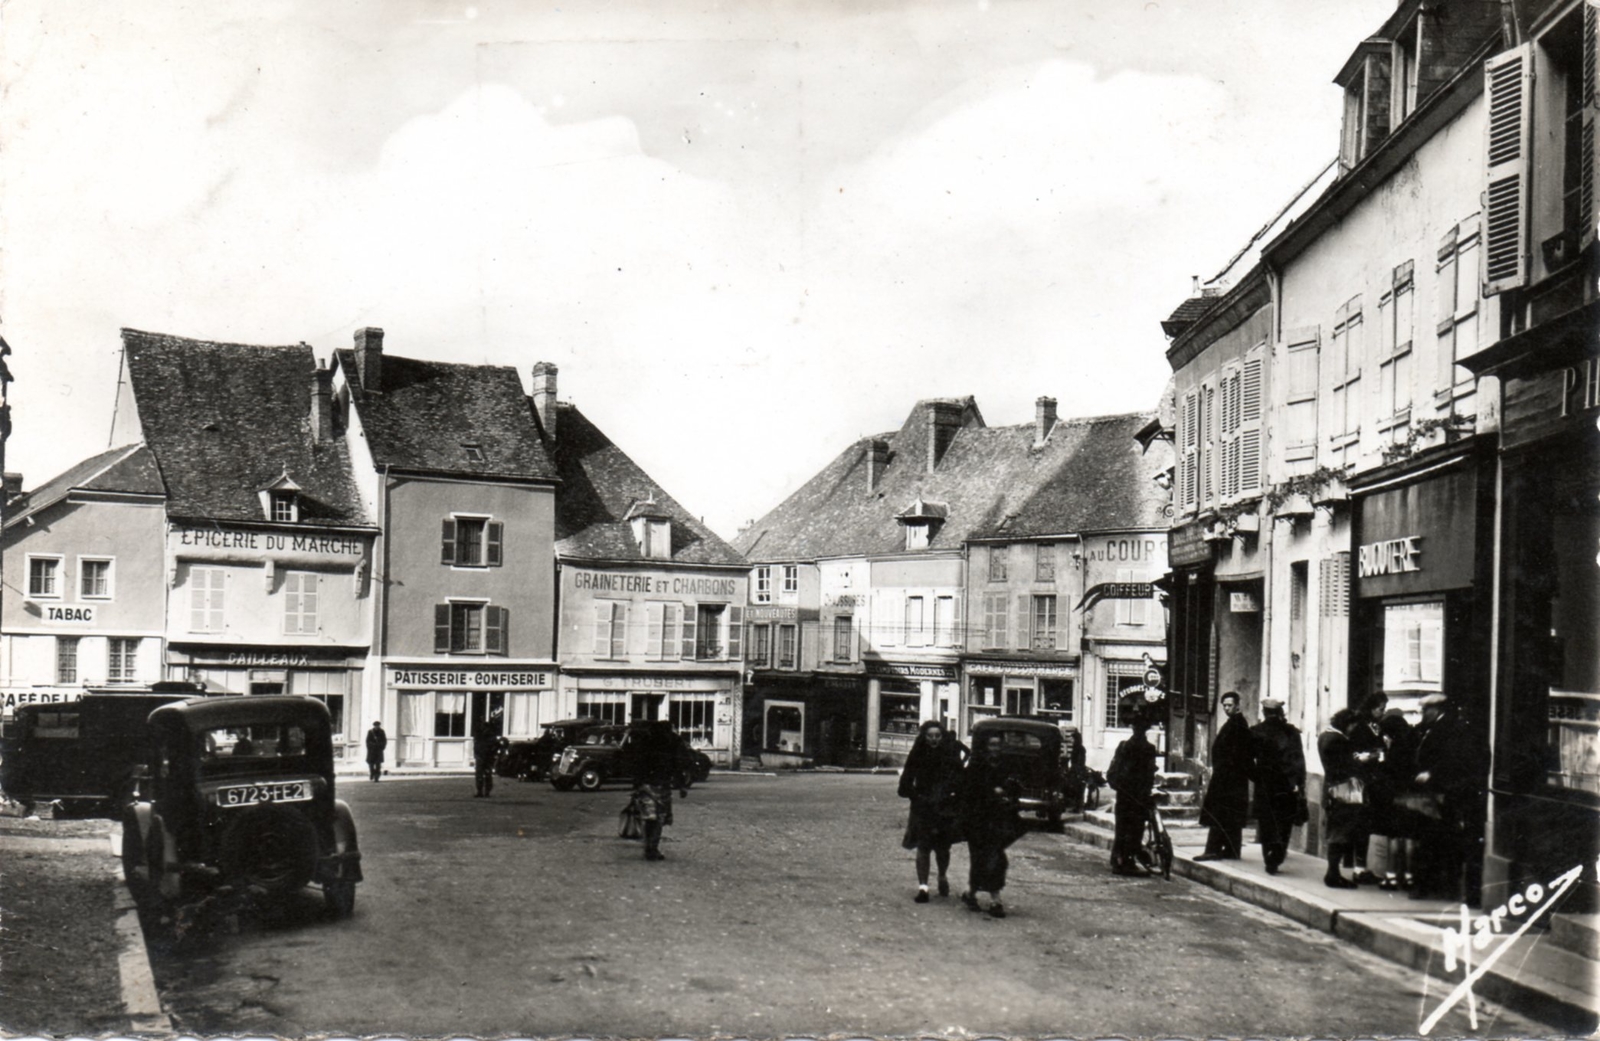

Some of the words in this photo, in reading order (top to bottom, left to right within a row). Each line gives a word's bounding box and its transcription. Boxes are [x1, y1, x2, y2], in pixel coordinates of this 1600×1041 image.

[266, 535, 285, 550] DU
[1089, 550, 1104, 561] AU
[575, 572, 652, 592] GRAINETERIE
[656, 581, 669, 592] ET
[673, 578, 736, 595] CHARBONS
[1103, 584, 1152, 597] COIFFEUR
[47, 607, 93, 621] TABAC
[1015, 666, 1073, 677] COMMERCE
[475, 672, 546, 686] CONFISERIE
[41, 693, 60, 703] DE
